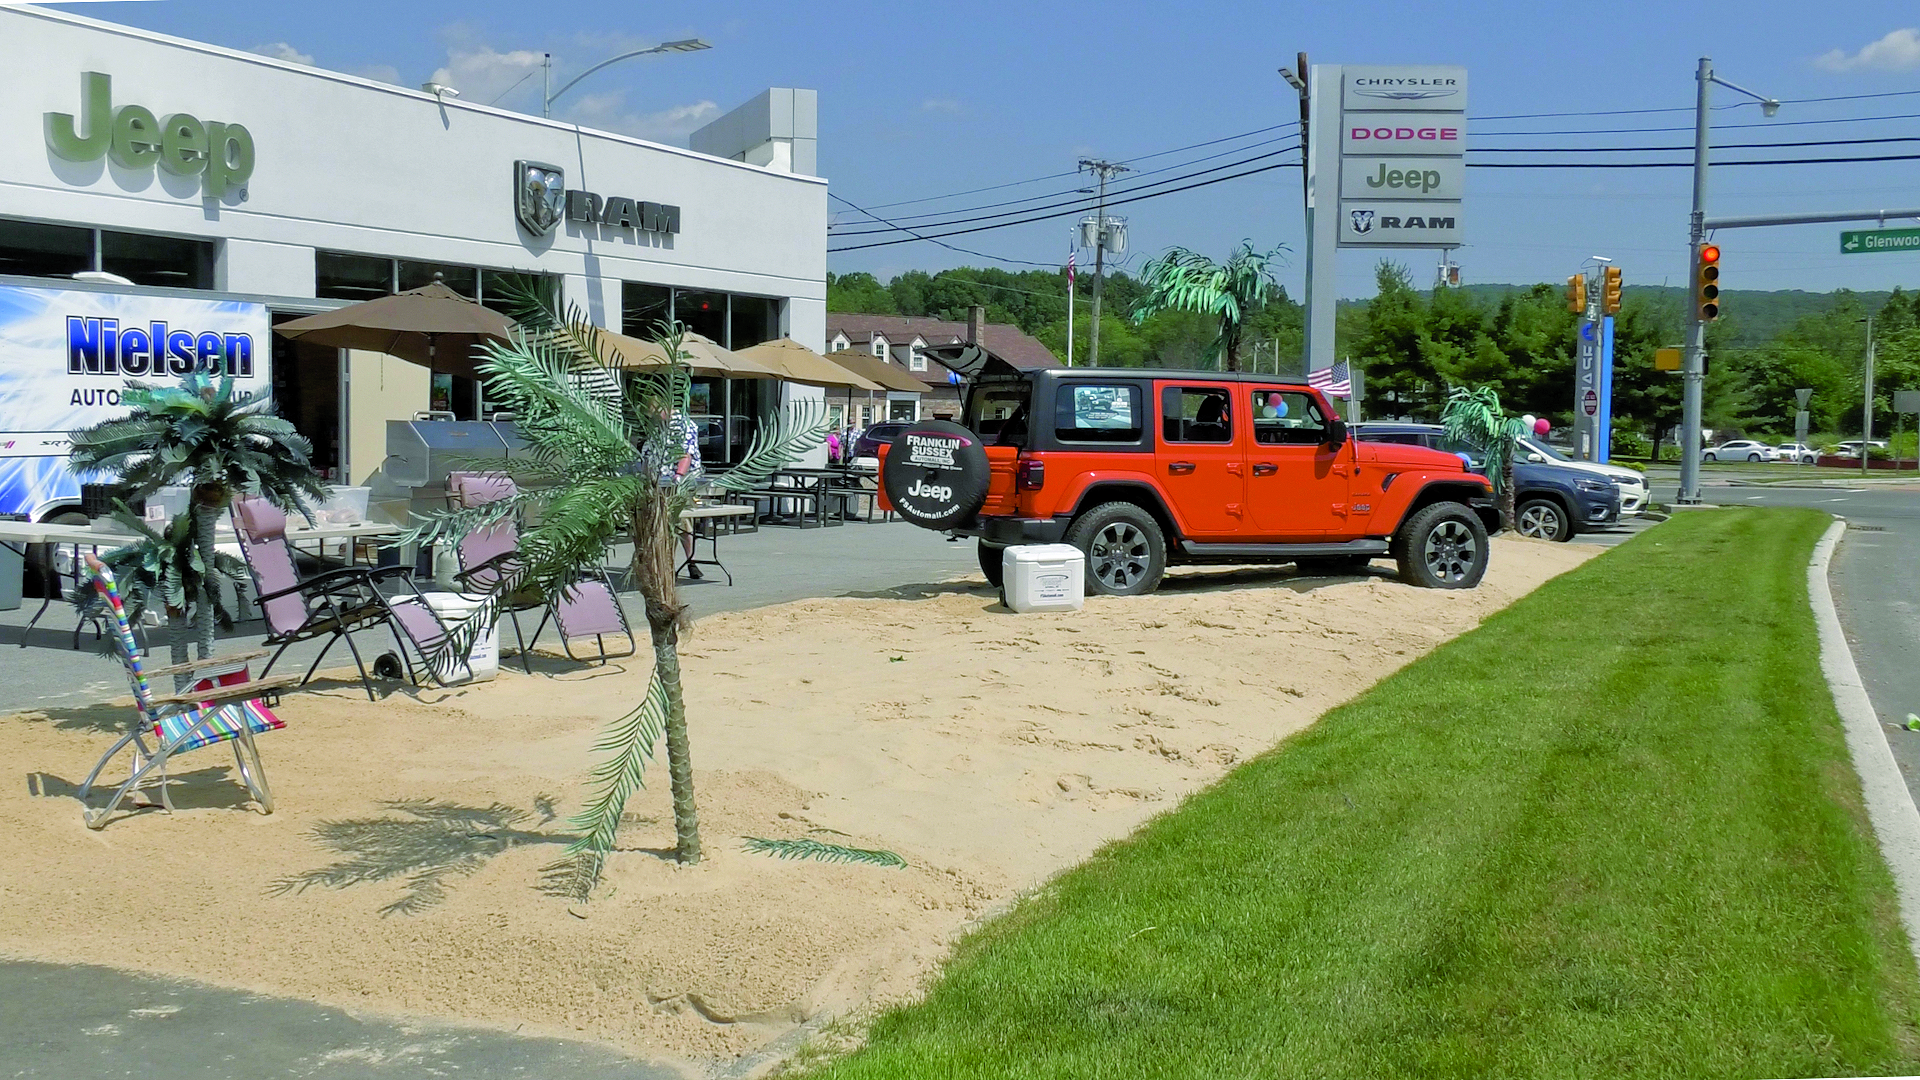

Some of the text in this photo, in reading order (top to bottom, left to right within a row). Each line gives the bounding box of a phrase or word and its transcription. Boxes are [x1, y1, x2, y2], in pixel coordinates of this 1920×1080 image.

[1356, 78, 1457, 86] CHRYSLER
[43, 71, 255, 197] Jeep
[1351, 128, 1458, 140] DODGE
[1366, 163, 1441, 193] Jeep
[566, 190, 680, 234] RAM
[1381, 216, 1455, 229] RAM
[66, 315, 254, 378] Nielsen
[906, 435, 961, 450] FRANKLIN
[911, 446, 954, 459] SUSSEX
[907, 479, 952, 503] Jeep
[899, 497, 960, 519] FSAutomall.com
